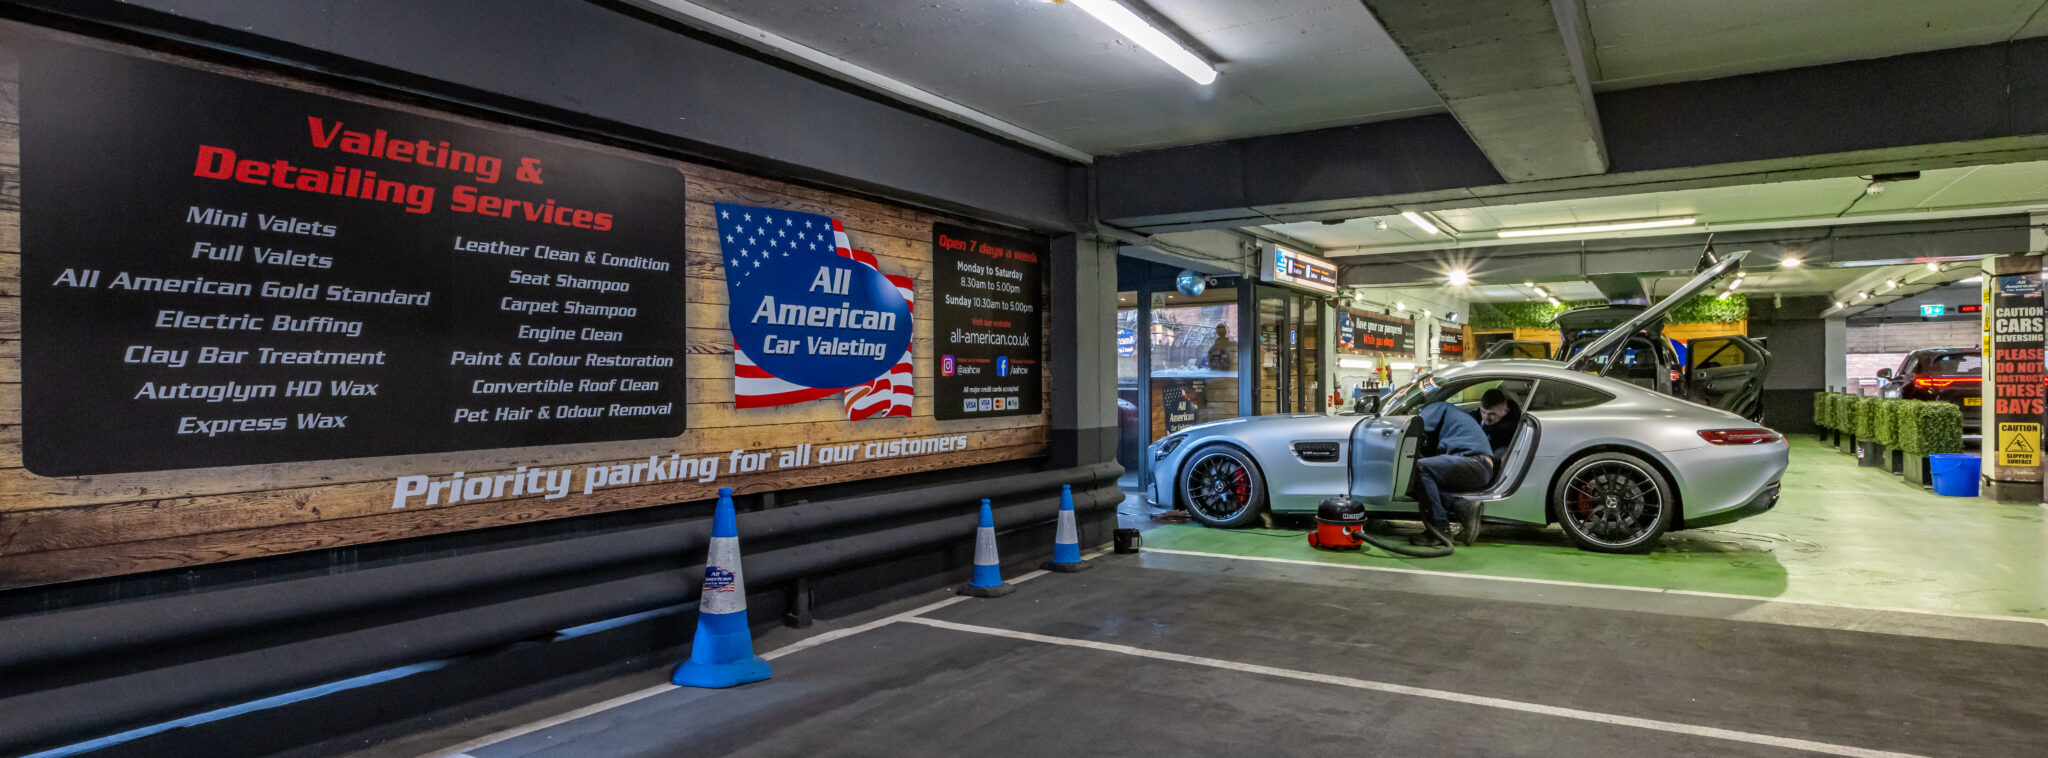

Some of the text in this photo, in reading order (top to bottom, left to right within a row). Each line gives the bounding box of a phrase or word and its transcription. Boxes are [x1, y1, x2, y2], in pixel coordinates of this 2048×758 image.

[308, 116, 543, 184] Valeting &
[194, 144, 612, 230] Detailing Services
[187, 207, 336, 236] Mini Valets
[192, 242, 332, 268] Full Valets
[454, 236, 669, 271] Leather Clean & Condition
[939, 235, 1038, 263] Open 7 days a week
[810, 266, 851, 294] All
[957, 260, 1023, 281] Monday to Saturday
[53, 269, 430, 305] All American Gold Standard
[509, 270, 629, 293] Seat Shampoo
[960, 276, 1021, 295] 8.30am to 5.00pm
[501, 297, 636, 318] Carpet Shampoo
[752, 296, 896, 330] American
[945, 294, 1034, 313] Sunday 10.30am to 5.00pm
[1996, 307, 2043, 317] CAUTION
[156, 311, 362, 336] Electric Buffing
[1355, 317, 1367, 330] Have
[1367, 321, 1378, 333] your
[1996, 318, 2043, 333] CARS
[518, 325, 622, 342] Engine Clean
[950, 328, 1029, 346] all-american.co.uk
[1996, 334, 2044, 342] REVERSING
[124, 346, 386, 367] Clay Bar Treatment
[764, 335, 886, 360] Car Valeting
[1996, 349, 2044, 360] PLEASE
[451, 352, 673, 366] Paint & Colour Restoration
[1995, 361, 2043, 373] DO NOT
[473, 379, 659, 393] Convertible Roof Clean
[1996, 374, 2044, 382] OBSTRUCT
[134, 381, 378, 402] Autoglym HD Wax
[1996, 384, 2045, 397] THESE
[454, 403, 672, 423] Pet Hair & Odour Removal
[965, 401, 977, 409] VISA
[1178, 401, 1186, 411] All
[1995, 398, 2045, 414] BAYS
[177, 413, 347, 437] Express Wax
[1169, 412, 1195, 422] American
[2001, 424, 2038, 432] CAUTION
[391, 434, 968, 508] Priority parking for all our customers
[1342, 511, 1365, 520] Henry
